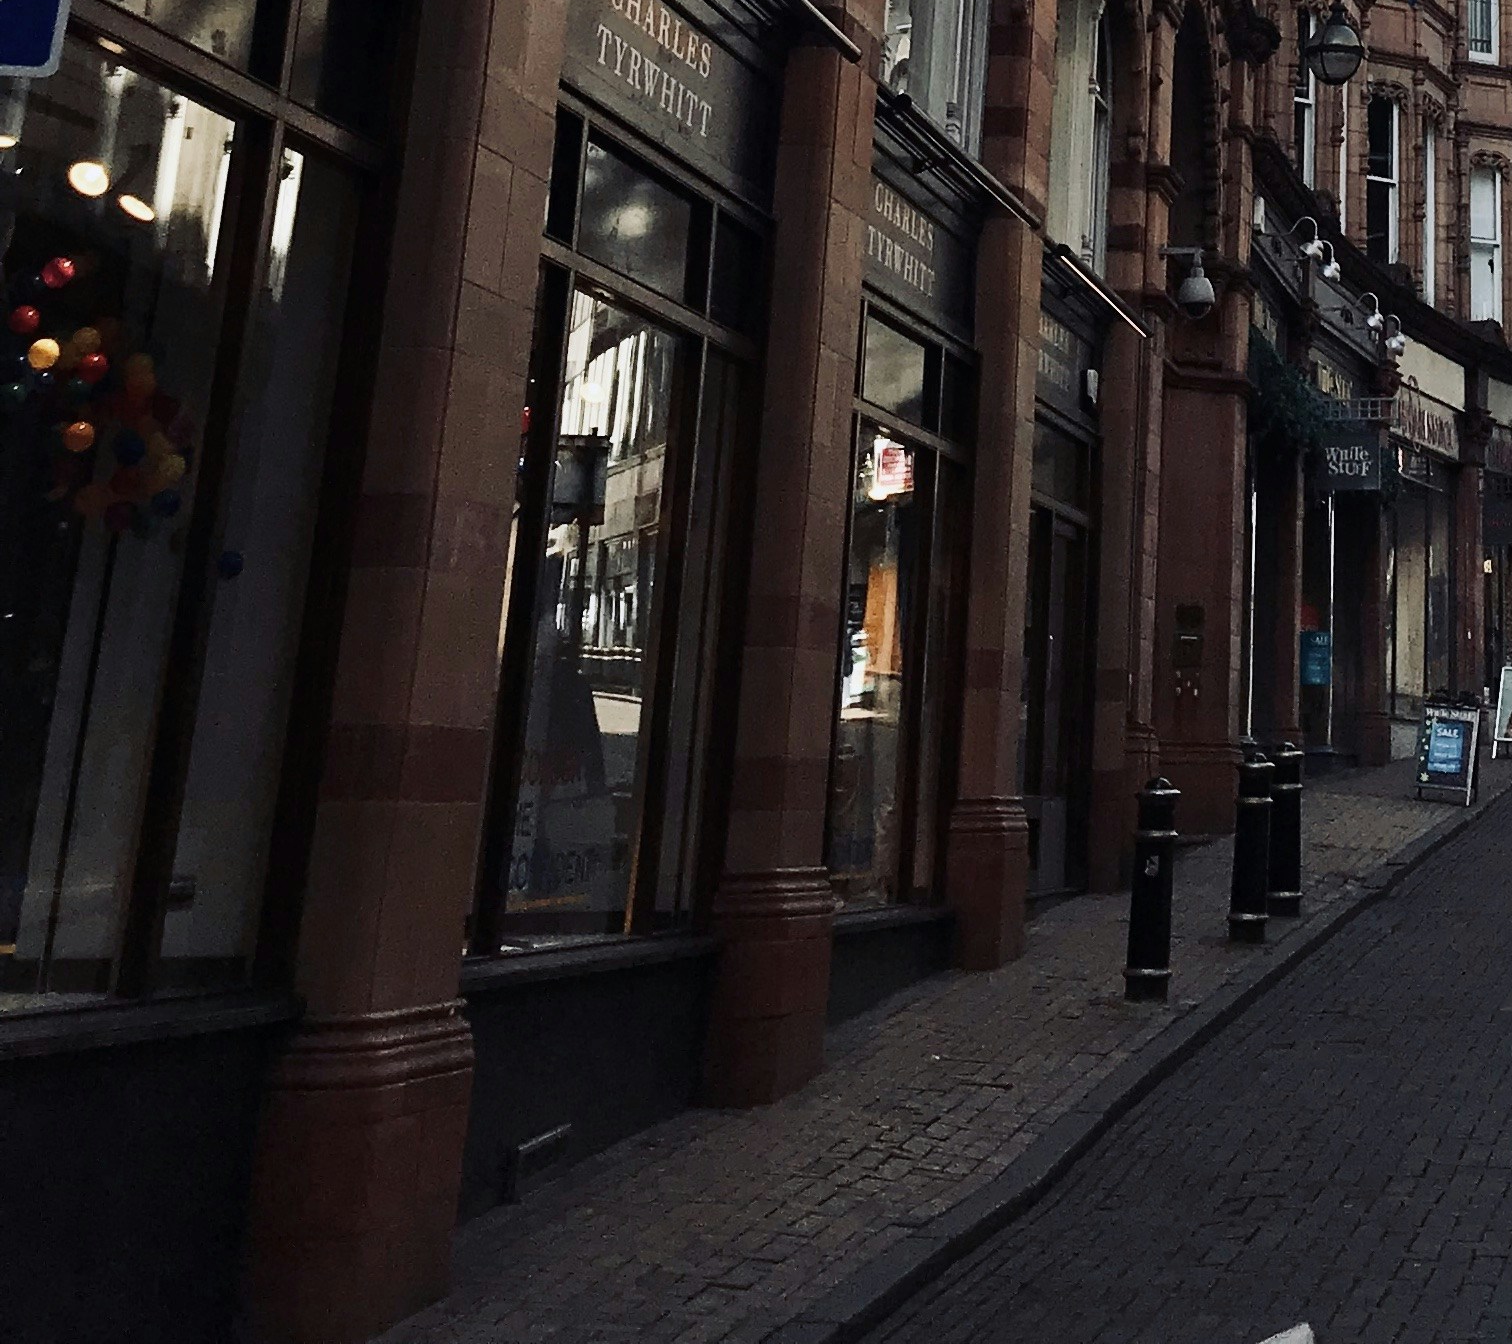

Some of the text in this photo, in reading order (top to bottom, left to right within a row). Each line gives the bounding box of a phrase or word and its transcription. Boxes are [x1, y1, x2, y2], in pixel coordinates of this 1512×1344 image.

[596, 23, 713, 138] TYRWHITT
[874, 182, 934, 252] CHARLES
[867, 224, 936, 299] TYRWHITT
[1435, 726, 1460, 740] SALE
